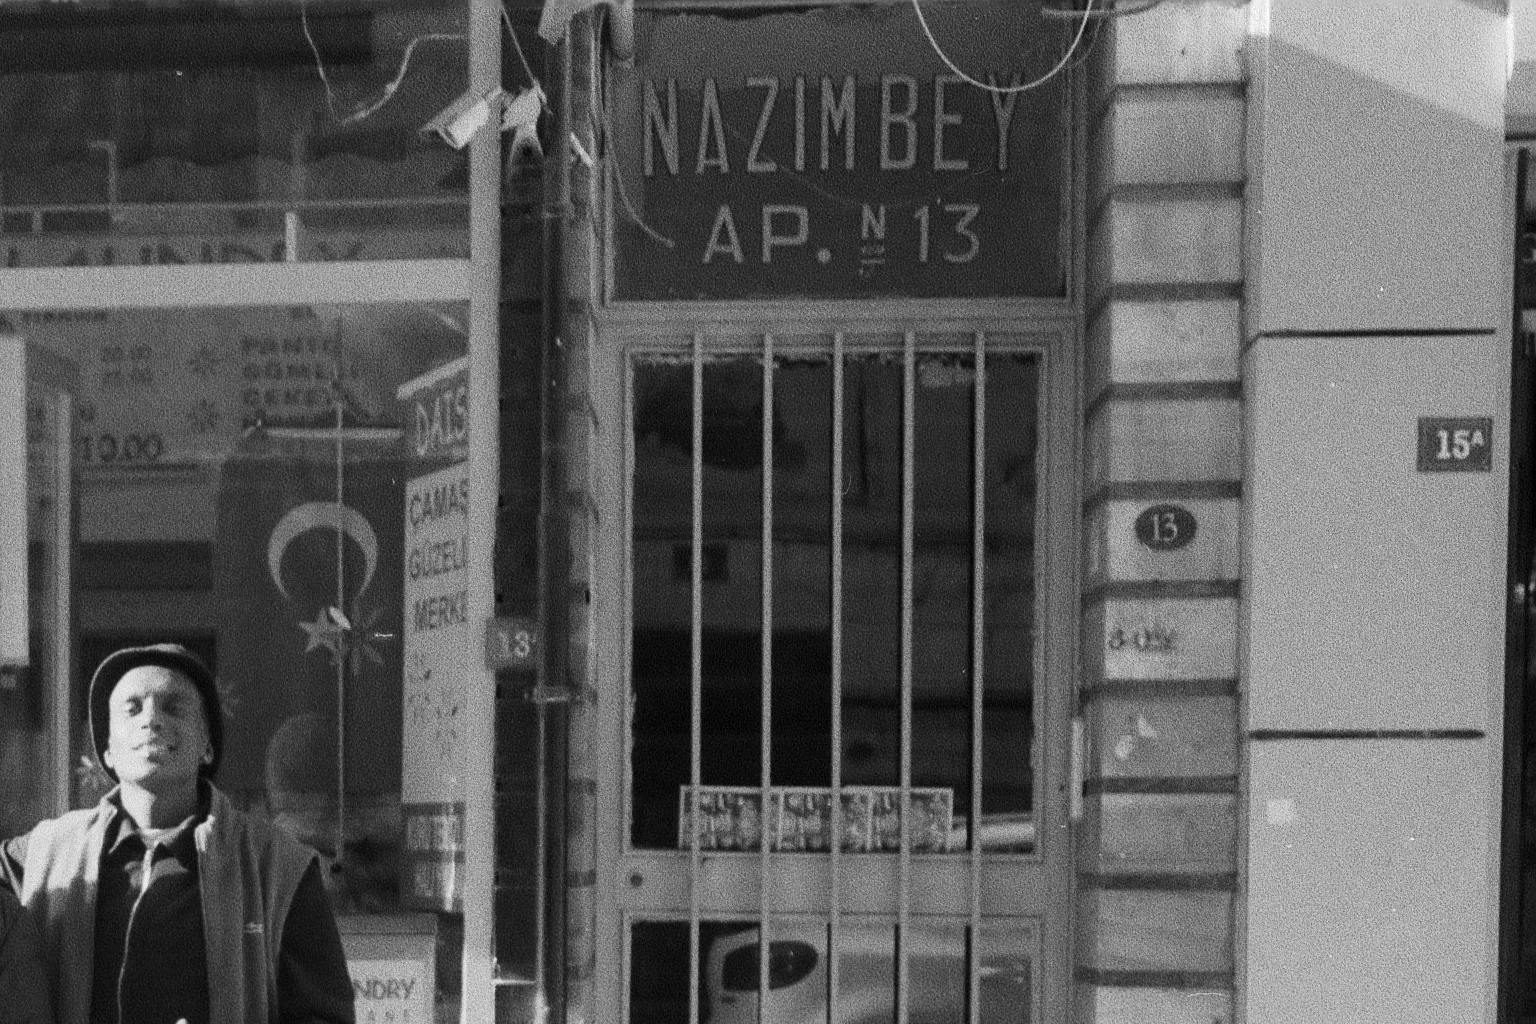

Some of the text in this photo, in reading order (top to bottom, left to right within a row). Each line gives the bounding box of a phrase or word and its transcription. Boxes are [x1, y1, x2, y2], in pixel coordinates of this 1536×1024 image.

[702, 203, 832, 263] AP.
[913, 203, 981, 263] 13
[415, 386, 469, 457] DAIS
[1151, 512, 1179, 542] 13
[498, 629, 532, 659] 13
